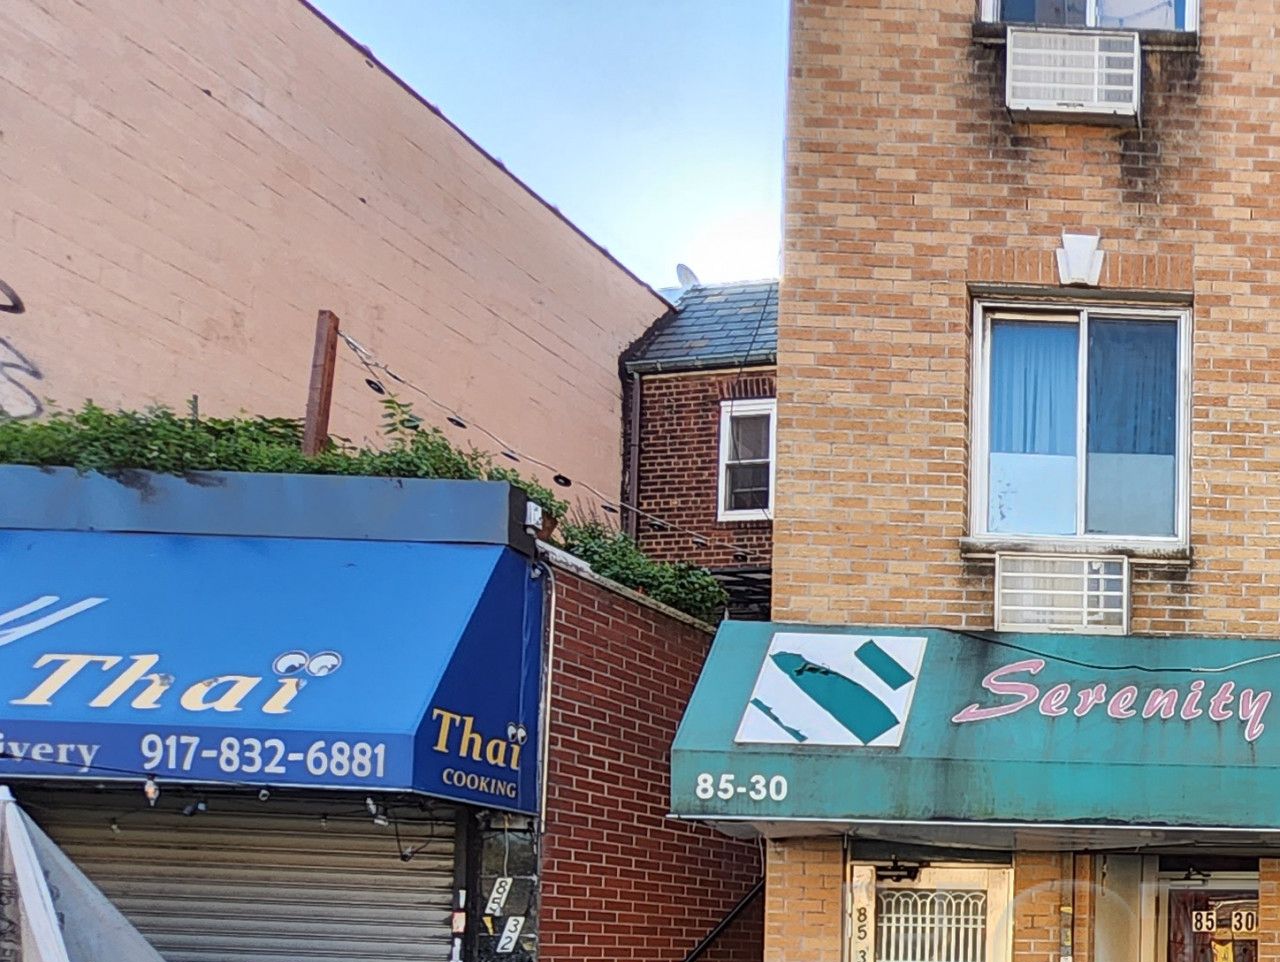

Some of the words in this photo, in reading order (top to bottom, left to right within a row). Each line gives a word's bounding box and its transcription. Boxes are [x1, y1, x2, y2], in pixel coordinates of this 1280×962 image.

[951, 658, 1272, 742] Serenity
[141, 734, 386, 778] 917-832-6881
[442, 767, 517, 799] COOKING
[695, 773, 789, 801] 85-30
[1194, 912, 1214, 931] 85
[1233, 912, 1255, 931] 30
